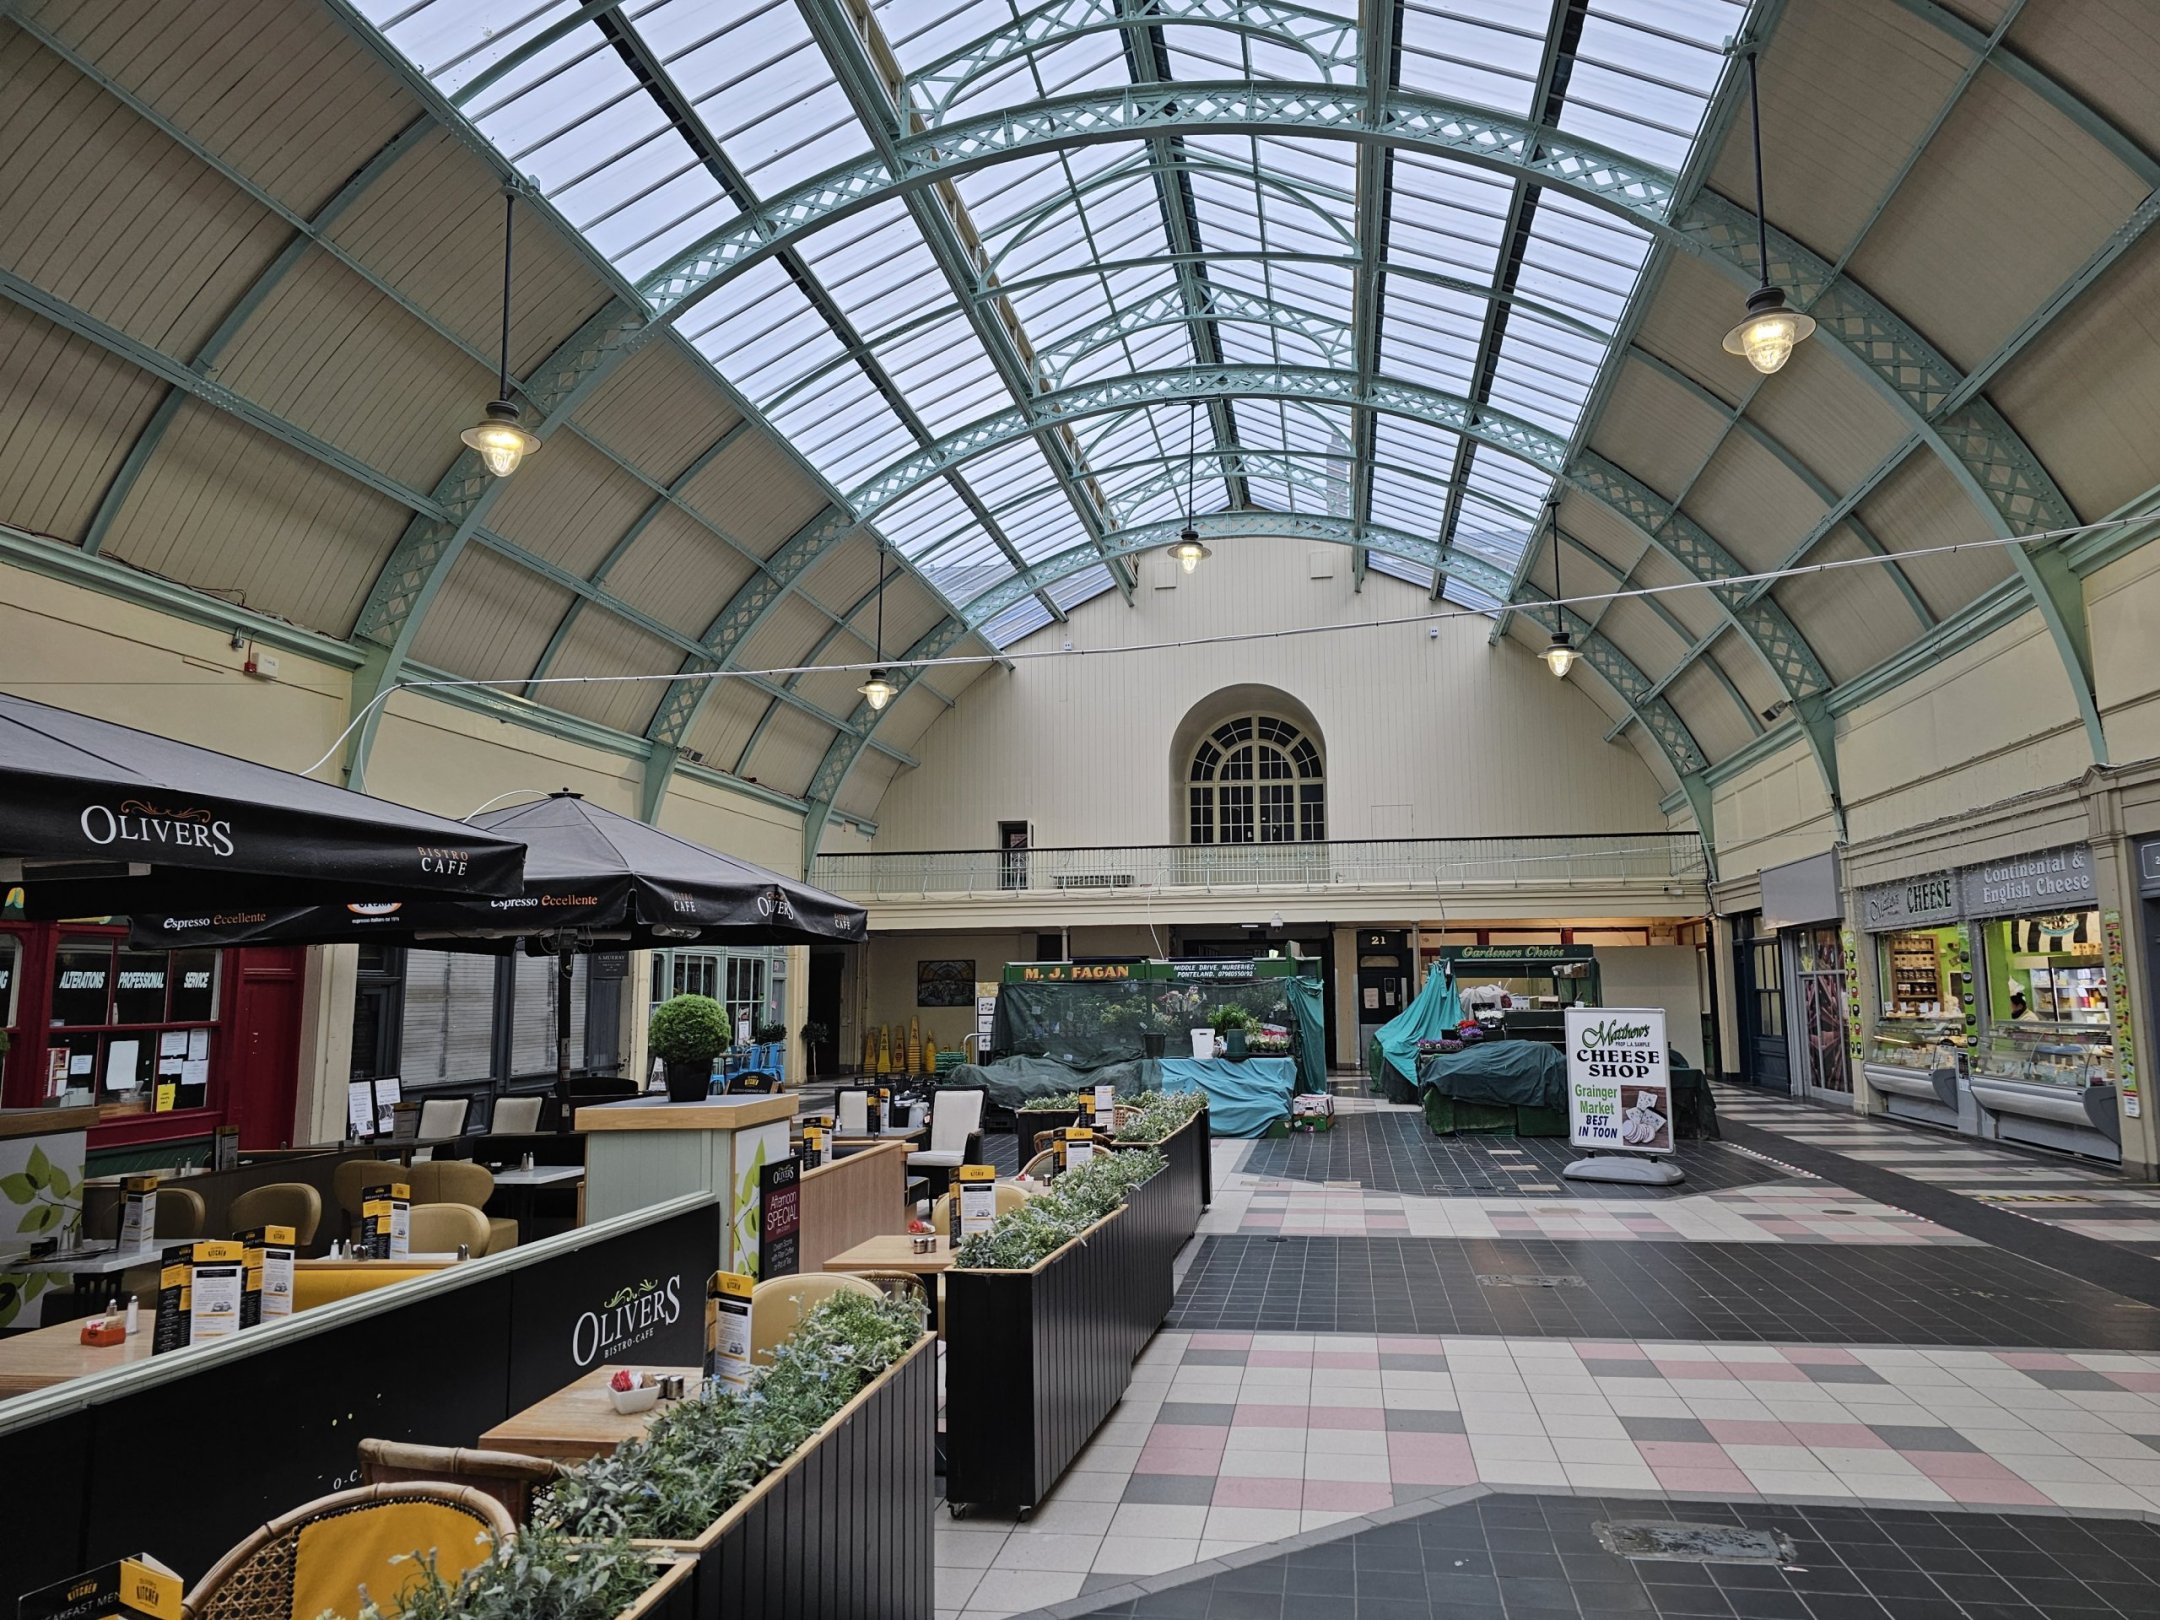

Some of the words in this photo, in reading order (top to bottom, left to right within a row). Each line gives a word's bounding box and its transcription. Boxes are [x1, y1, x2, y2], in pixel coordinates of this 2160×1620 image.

[81, 804, 234, 856] OLIVERS
[417, 846, 469, 861] BISTRO
[421, 857, 468, 876] CAFE
[1983, 850, 2066, 884] Continental
[2072, 851, 2085, 870] &
[1906, 879, 1952, 914] CHEESE
[1983, 880, 2031, 905] English
[2036, 873, 2090, 896] Cheese
[541, 894, 598, 906] eccellente
[674, 900, 697, 912] CAFE
[163, 917, 210, 931] espresso
[213, 912, 267, 926] eccellente
[835, 919, 850, 930] CAFE
[1371, 936, 1386, 945] 21
[1462, 946, 1522, 958] Gardeners
[1525, 945, 1565, 958] Choice
[59, 971, 106, 989] ALTERATIONS
[117, 972, 164, 989] PROFESSIONAL
[184, 972, 210, 989] SERVICE
[1024, 968, 1044, 979] M.
[1048, 967, 1065, 980] J.
[1072, 966, 1129, 979] FAGAN
[1576, 1049, 1660, 1064] CHEESE
[1588, 1064, 1650, 1078] SHOP
[1575, 1084, 1618, 1101] Grainger
[1580, 1100, 1615, 1115] Market
[1585, 1115, 1609, 1126] BEST
[1578, 1126, 1589, 1137] IN
[1593, 1127, 1618, 1139] TOON
[773, 1166, 794, 1184] OLIVERS
[770, 1191, 796, 1211] Afternoon
[767, 1203, 798, 1231] SPECIAL
[572, 1274, 680, 1367] OLIVERS
[604, 1327, 655, 1359] BISTRO-CAFE
[67, 1582, 98, 1602] KITCHEN
[136, 1585, 159, 1607] KITCHEN
